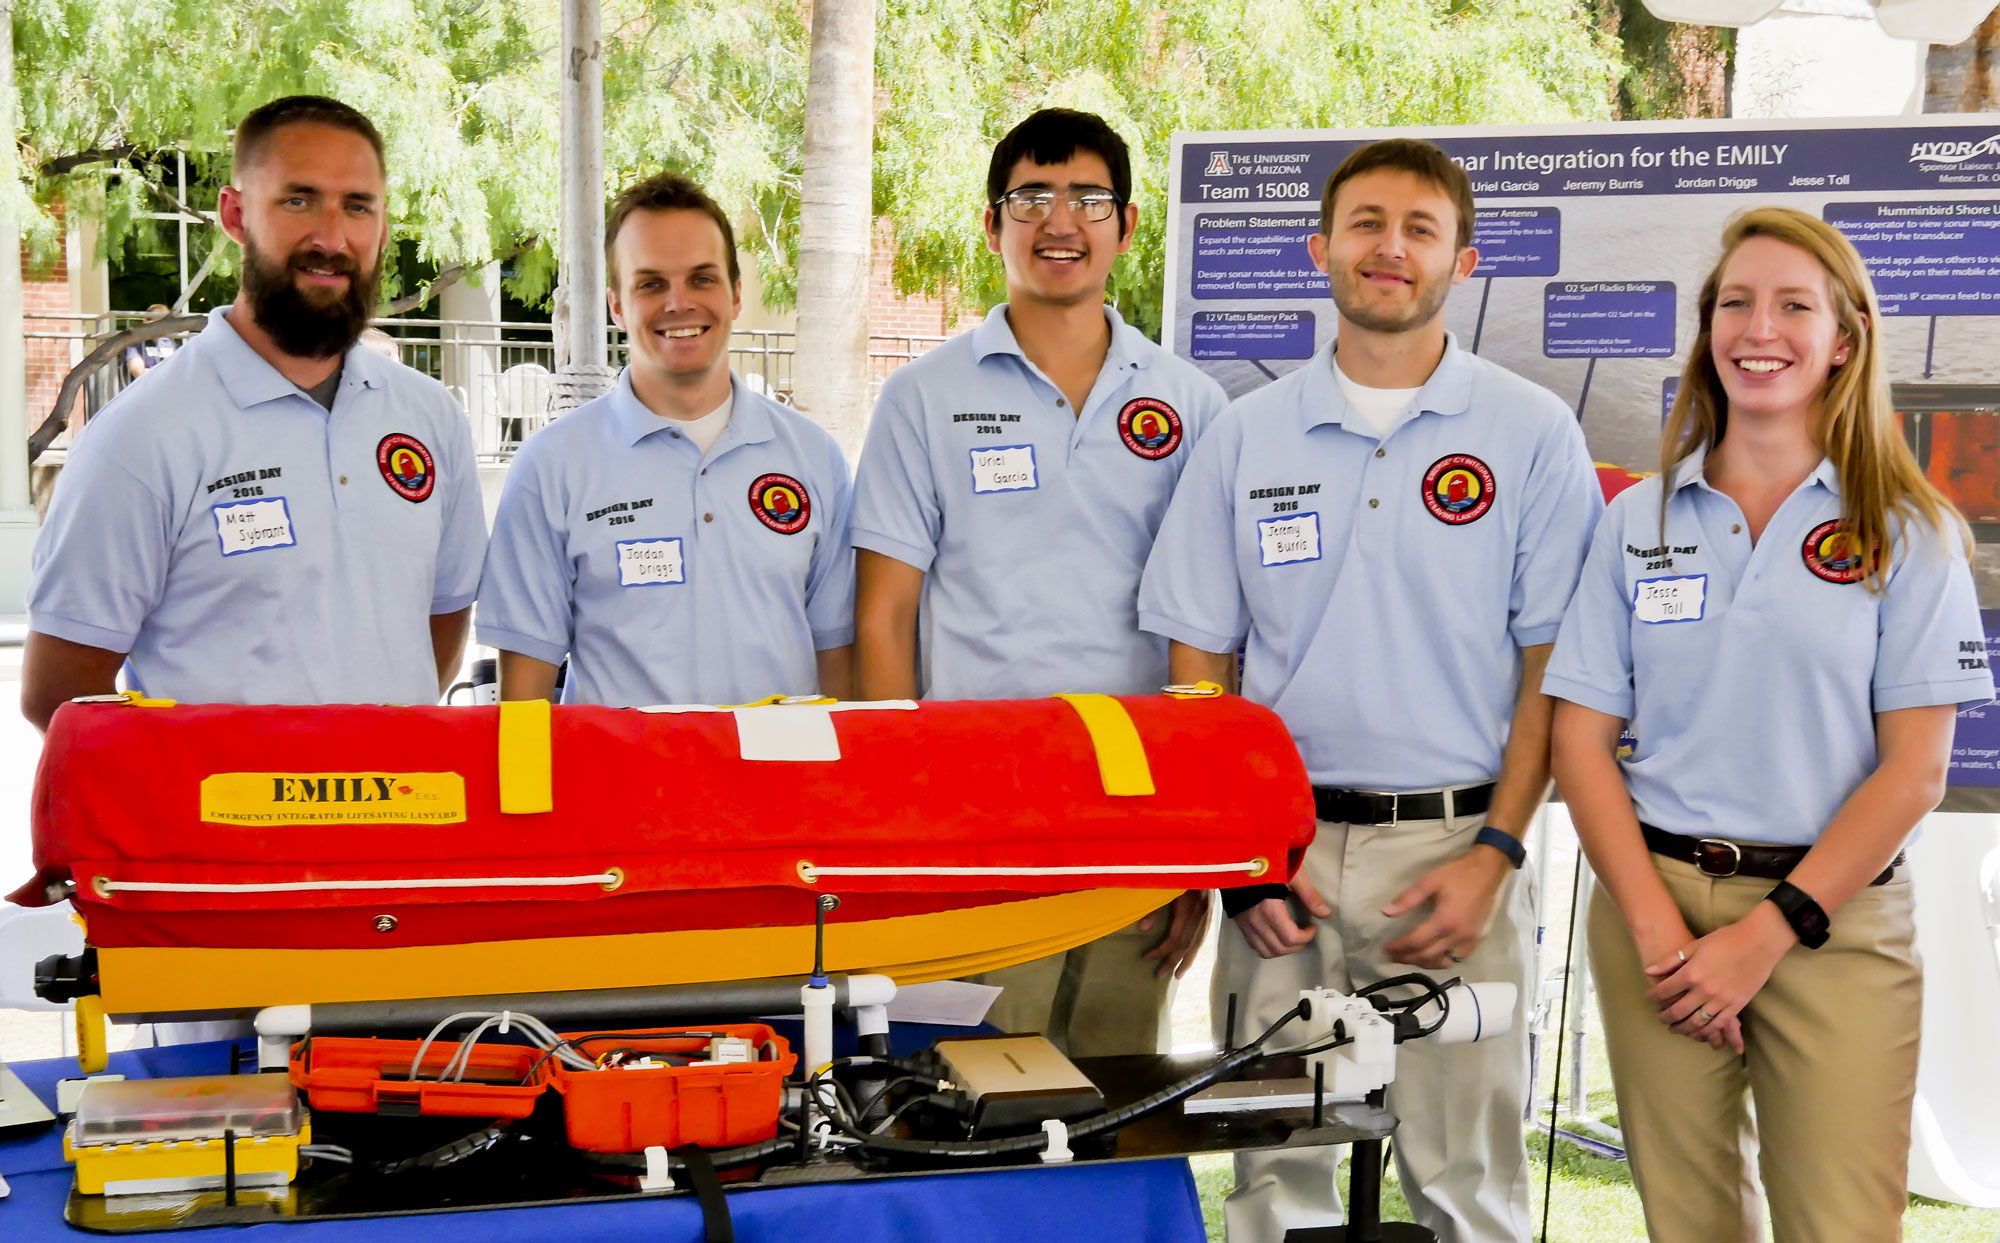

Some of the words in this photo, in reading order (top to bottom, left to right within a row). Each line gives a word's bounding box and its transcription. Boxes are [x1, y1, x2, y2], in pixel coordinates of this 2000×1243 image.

[1232, 154, 1250, 164] THE
[1254, 153, 1311, 164] UNIVERSITY
[1450, 155, 1489, 171] nar
[1494, 149, 1624, 175] Integration
[1630, 146, 1664, 167] for
[1669, 145, 1710, 167] the
[1716, 144, 1788, 166] EMILY
[1239, 166, 1252, 175] OF
[1254, 165, 1302, 175] ARIZONA
[1919, 163, 1957, 172] Sponsor
[1959, 161, 1994, 171] Liaison:
[1471, 181, 1498, 192] Uriel
[1501, 180, 1540, 192] Garcia
[1563, 180, 1606, 192] Jeremy
[1609, 178, 1644, 190] Burris
[1674, 177, 1716, 189] Jordan
[1718, 176, 1758, 190] Driggs
[1788, 175, 1825, 187] Jesse
[1827, 174, 1850, 186] Toll
[1939, 174, 1976, 183] Mentor:
[1199, 184, 1249, 199] Team
[1256, 182, 1309, 198] 15008
[1500, 209, 1538, 218] Antenna
[1878, 204, 1953, 216] Humminbird
[1956, 204, 1990, 215] Shore
[1200, 217, 1246, 228] Problem
[1249, 217, 1305, 228] Statement
[1307, 218, 1320, 227] an
[1832, 220, 1862, 229] Allows
[1864, 220, 1905, 230] operator
[1907, 220, 1917, 228] to
[1919, 220, 1942, 228] view
[1199, 236, 1231, 245] Expand
[1232, 235, 1246, 243] the
[1247, 235, 1295, 245] capabilities
[1296, 234, 1305, 242] of
[1882, 232, 1894, 242] by
[1895, 231, 1912, 240] the
[1913, 231, 1964, 240] transducer
[1199, 247, 1225, 255] search
[1227, 247, 1243, 255] and
[1245, 247, 1281, 256] recovery
[1892, 257, 1912, 266] app
[1913, 255, 1943, 264] allows
[1945, 255, 1976, 264] others
[1977, 255, 1988, 264] to
[1197, 271, 1227, 280] Design
[1253, 270, 1285, 278] module
[1298, 269, 1310, 277] be
[1877, 268, 1911, 278] display
[1927, 267, 1950, 276] their
[1951, 267, 1985, 276] mobile
[1197, 282, 1234, 290] removed
[1236, 281, 1256, 289] from
[1258, 281, 1272, 289] the
[1274, 281, 1305, 291] generic
[1307, 280, 1330, 289] EMILY
[1579, 284, 1599, 292] Surf
[1599, 283, 1625, 292] Radio
[1626, 283, 1656, 293] Bridge
[1909, 292, 1919, 300] IP
[1957, 291, 1979, 300] feed
[1981, 292, 1992, 300] to
[1206, 313, 1216, 322] 12
[1217, 313, 1225, 321] V
[1225, 313, 1246, 321] Tattu
[1247, 313, 1277, 323] Battery
[1279, 312, 1299, 321] Pack
[953, 413, 996, 423] DESIGN
[1000, 413, 1021, 422] DAY
[976, 425, 1002, 434] 2016
[978, 455, 1005, 467] Uriel
[206, 470, 257, 494] DESIGN
[259, 467, 282, 480] DAY
[993, 472, 1028, 484] Garcia
[1465, 458, 1494, 493] INTEGRATED
[233, 486, 263, 499] 2016
[1249, 486, 1295, 499] DESIGN
[1299, 484, 1321, 496] DAY
[586, 502, 629, 522] DESIGN
[631, 498, 654, 510] DAY
[1273, 501, 1298, 513] 2016
[1425, 490, 1455, 521] LIFESAVING
[226, 511, 256, 525] Matt
[608, 515, 635, 526] 2016
[239, 526, 286, 544] Sybrant
[1267, 524, 1300, 538] Jeremy
[1277, 539, 1308, 553] Burris
[1673, 545, 1698, 555] DAY
[626, 548, 664, 560] Jordan
[639, 563, 673, 577] Driggs
[1646, 586, 1678, 600] Jesse
[1661, 602, 1683, 615] Toll
[1959, 641, 1986, 654] AQU
[1969, 710, 1986, 718] the
[1967, 748, 2000, 758] longer
[1961, 762, 1995, 770] waters,
[271, 777, 397, 803] EMILY
[210, 811, 273, 821] EMERGENCY
[277, 811, 344, 821] INTEGRATED
[346, 811, 408, 820] LIFESAVING
[410, 811, 458, 820] LANYARD
